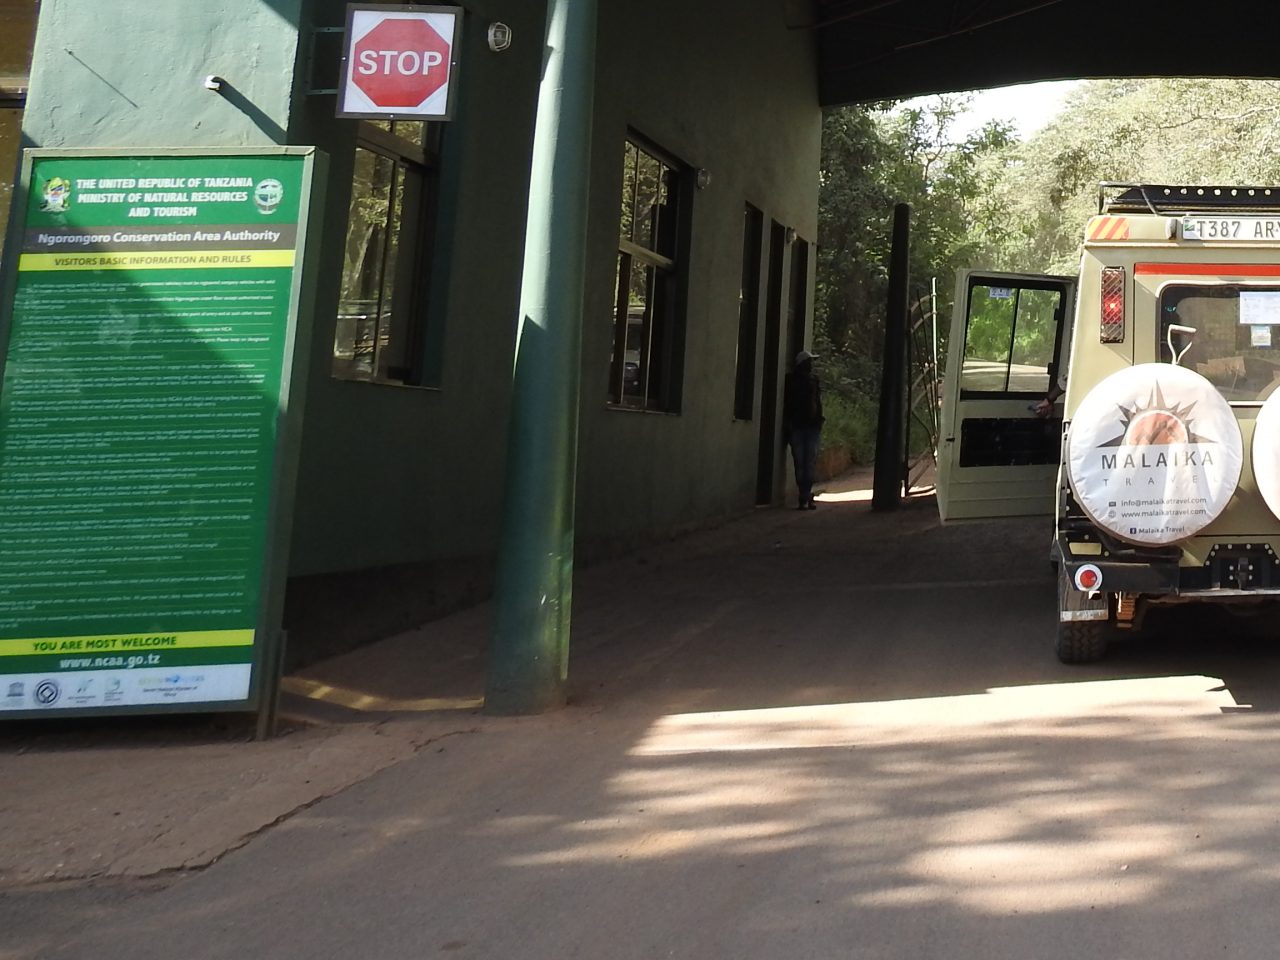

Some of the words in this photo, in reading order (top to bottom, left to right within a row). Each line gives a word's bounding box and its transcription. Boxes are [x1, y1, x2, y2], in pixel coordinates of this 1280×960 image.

[358, 50, 442, 76] STOP
[76, 179, 97, 189] THE
[99, 178, 135, 189] UNITED
[138, 178, 185, 189] REPUBLIC
[186, 178, 201, 188] OF
[204, 177, 253, 188] TANZANIA
[77, 192, 125, 203] MINISTRY
[127, 192, 142, 203] OF
[143, 192, 188, 202] NATURAL
[191, 191, 248, 202] RESOURCES
[128, 207, 150, 218] AND
[152, 206, 197, 217] TOURISM
[1197, 221, 1241, 238] T387
[38, 233, 111, 246] Ngorongoro
[113, 230, 192, 243] Conservation
[193, 230, 221, 242] Area
[223, 229, 281, 243] Authority
[54, 257, 97, 266] VISITORS
[99, 256, 127, 265] BASIC
[130, 255, 195, 265] INFORMATION
[197, 255, 219, 264] AND
[221, 254, 252, 263] RULES
[1101, 451, 1213, 469] MALAIKA
[1121, 497, 1207, 507] info@malaikatravel.com
[1121, 508, 1207, 518] www.malaikatravel.com
[32, 642, 58, 651] YOU
[60, 640, 83, 650] ARE
[86, 639, 118, 649] MOST
[121, 636, 177, 647] WELCOME
[59, 653, 161, 669] www.ncaa.go.tz
